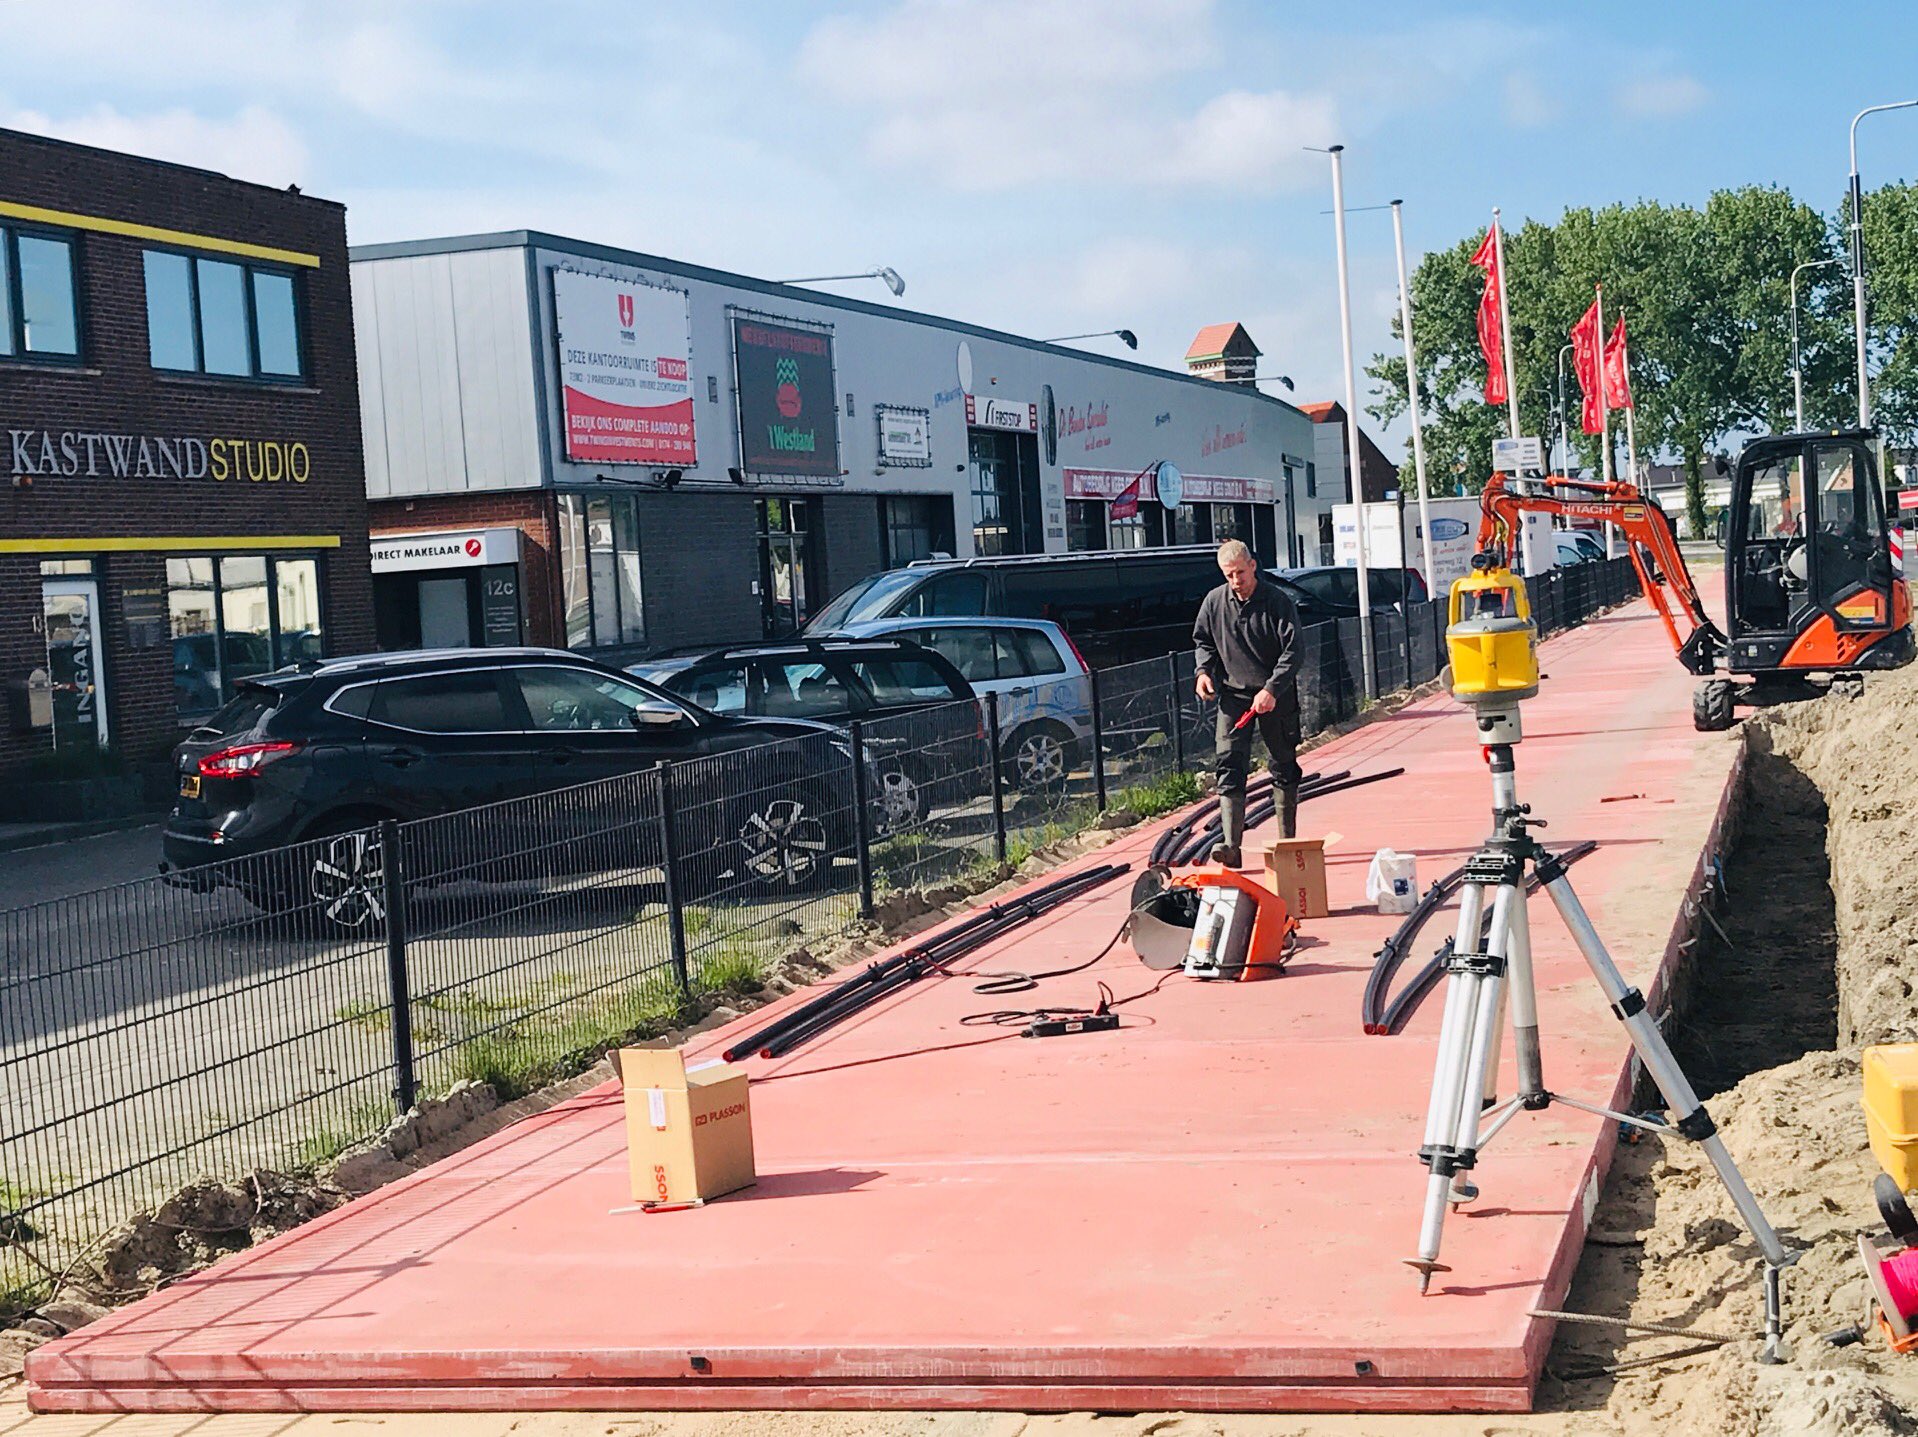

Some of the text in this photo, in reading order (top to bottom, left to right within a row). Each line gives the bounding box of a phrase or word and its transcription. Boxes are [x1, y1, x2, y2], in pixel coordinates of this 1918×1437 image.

[567, 349, 586, 365] DEZE
[588, 351, 650, 373] KANTOORRUIMTE
[659, 360, 667, 375] TE
[667, 362, 686, 377] KOOP
[597, 416, 613, 431] ONS
[613, 418, 650, 434] COMPLETE
[773, 424, 816, 452] Westland
[1561, 504, 1613, 515] HITACHI
[404, 545, 461, 558] MAKELAAR
[709, 1103, 746, 1122] PLASSON
